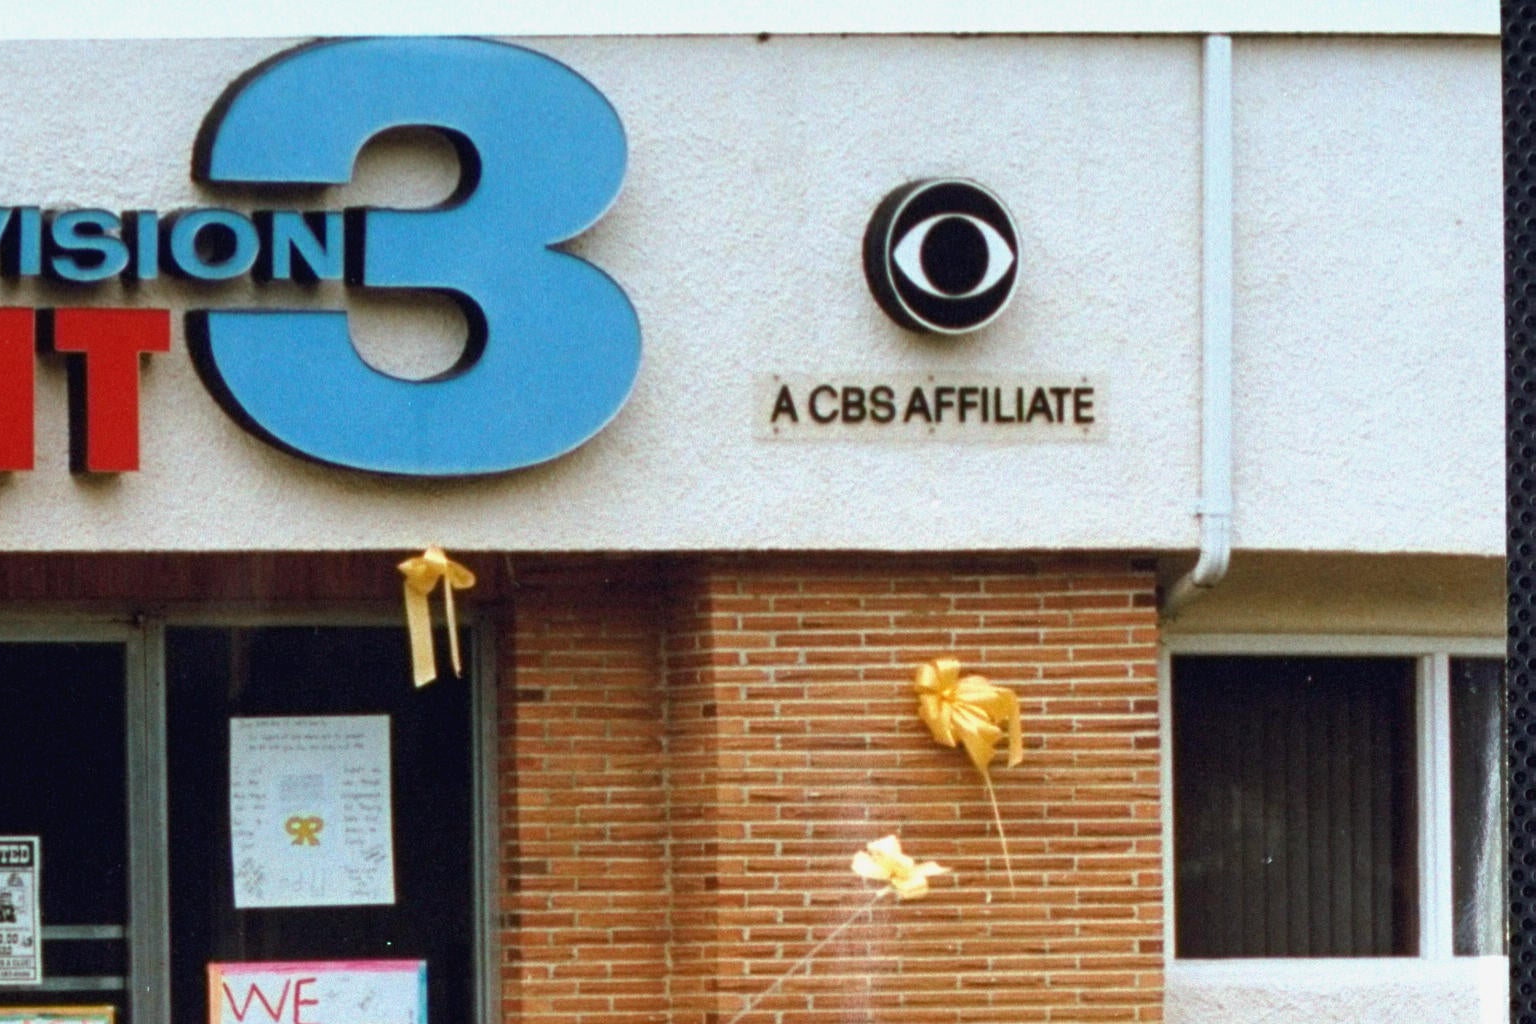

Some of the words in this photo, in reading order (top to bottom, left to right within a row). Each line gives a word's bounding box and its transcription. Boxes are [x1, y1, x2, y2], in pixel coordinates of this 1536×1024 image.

[185, 36, 643, 477] 3
[770, 384, 799, 424] A
[808, 384, 897, 425] CBS
[903, 386, 1095, 425] AFFILIATE
